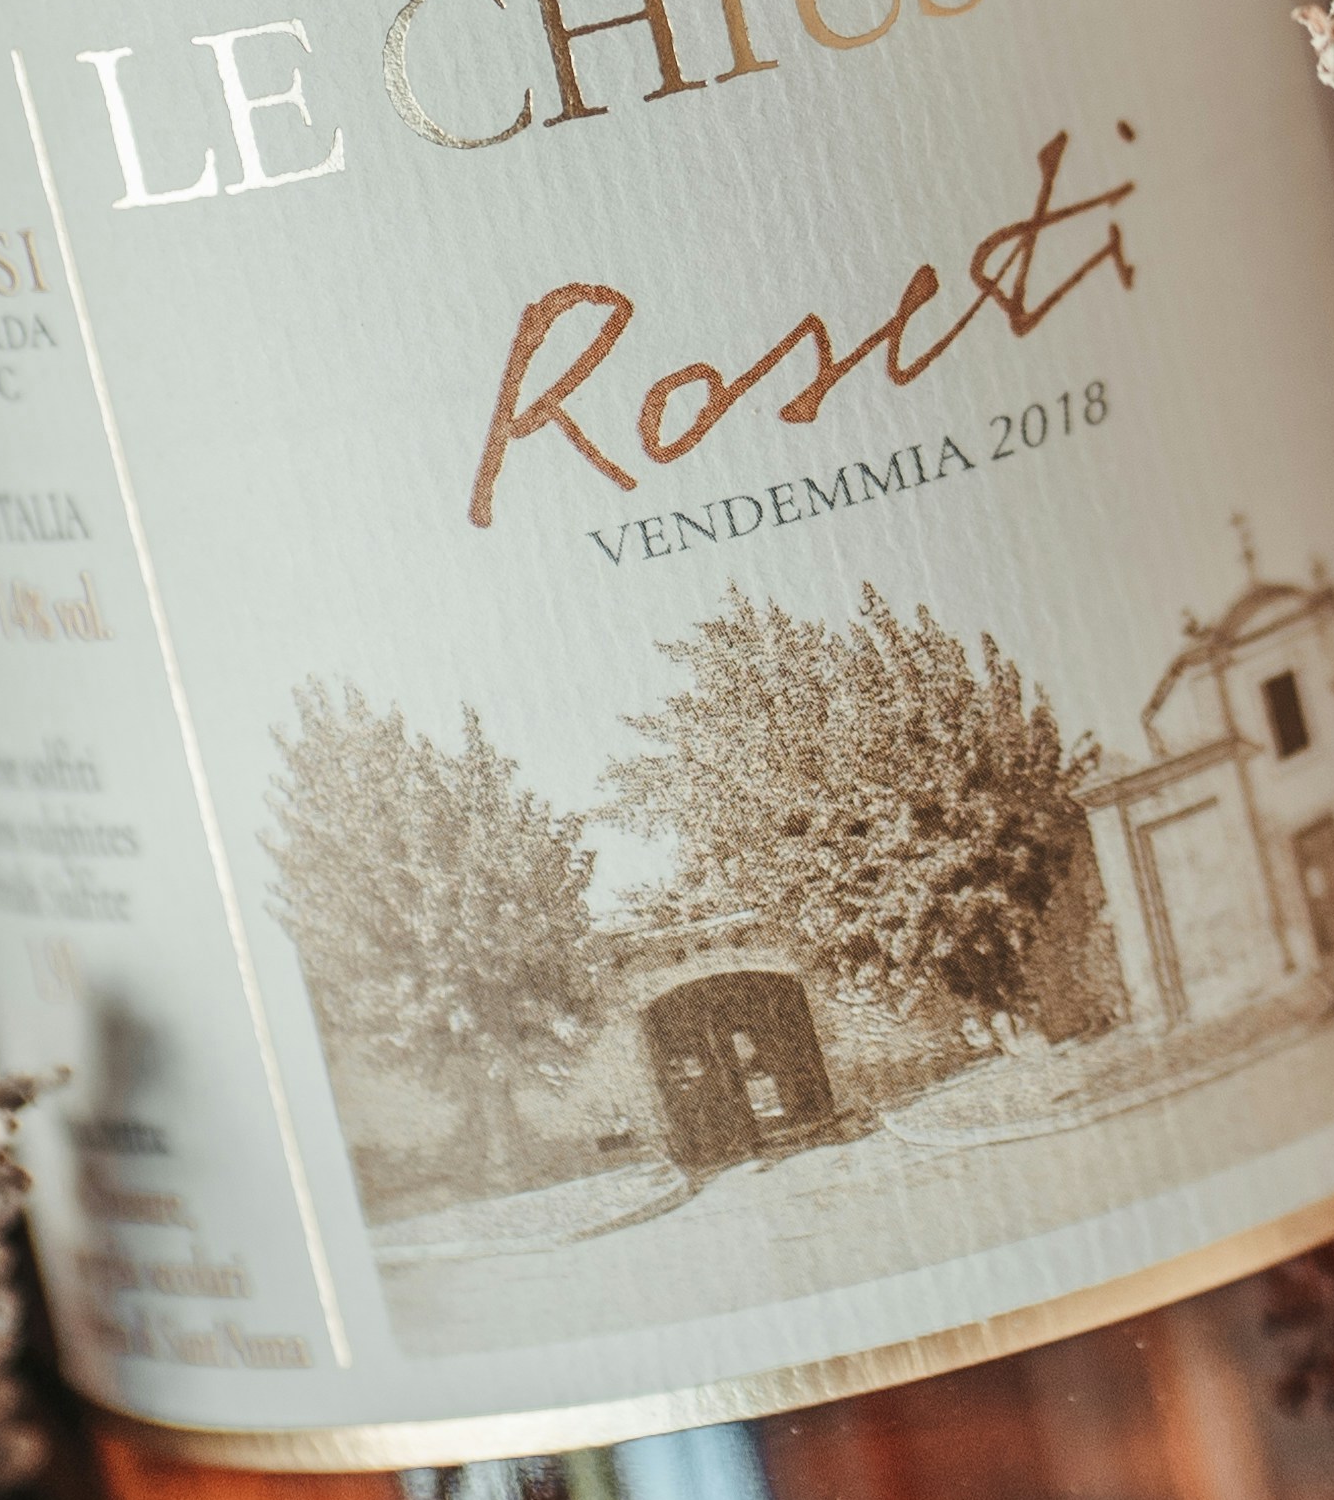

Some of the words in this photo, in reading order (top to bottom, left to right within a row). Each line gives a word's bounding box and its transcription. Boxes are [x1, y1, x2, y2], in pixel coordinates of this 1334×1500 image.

[75, 18, 345, 209] LE
[468, 120, 1136, 529] Roseti
[588, 434, 975, 566] VENDEMMIA
[988, 380, 1109, 461] 2018
